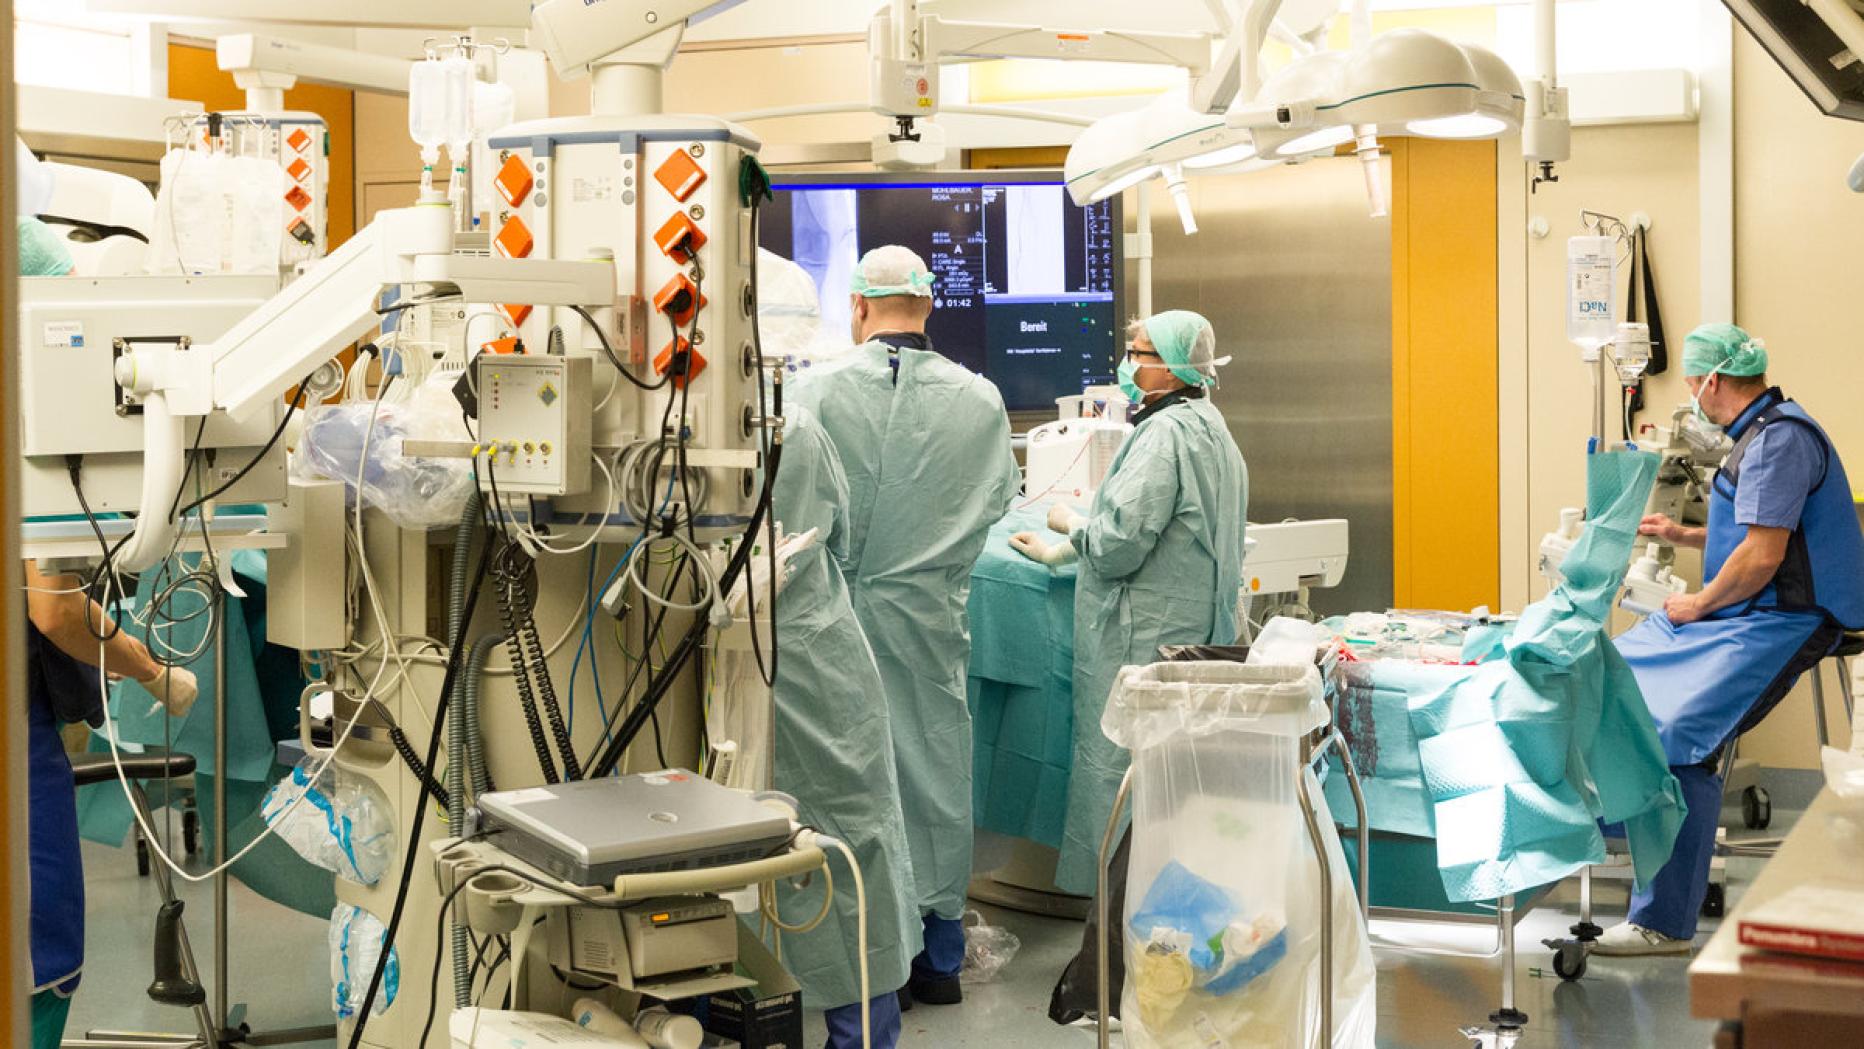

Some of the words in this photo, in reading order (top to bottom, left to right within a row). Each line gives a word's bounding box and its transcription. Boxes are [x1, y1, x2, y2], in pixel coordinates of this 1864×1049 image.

[954, 245, 963, 254] A
[946, 299, 972, 307] 01:42
[1579, 301, 1607, 312] NaCl
[1020, 320, 1048, 332] Bereit
